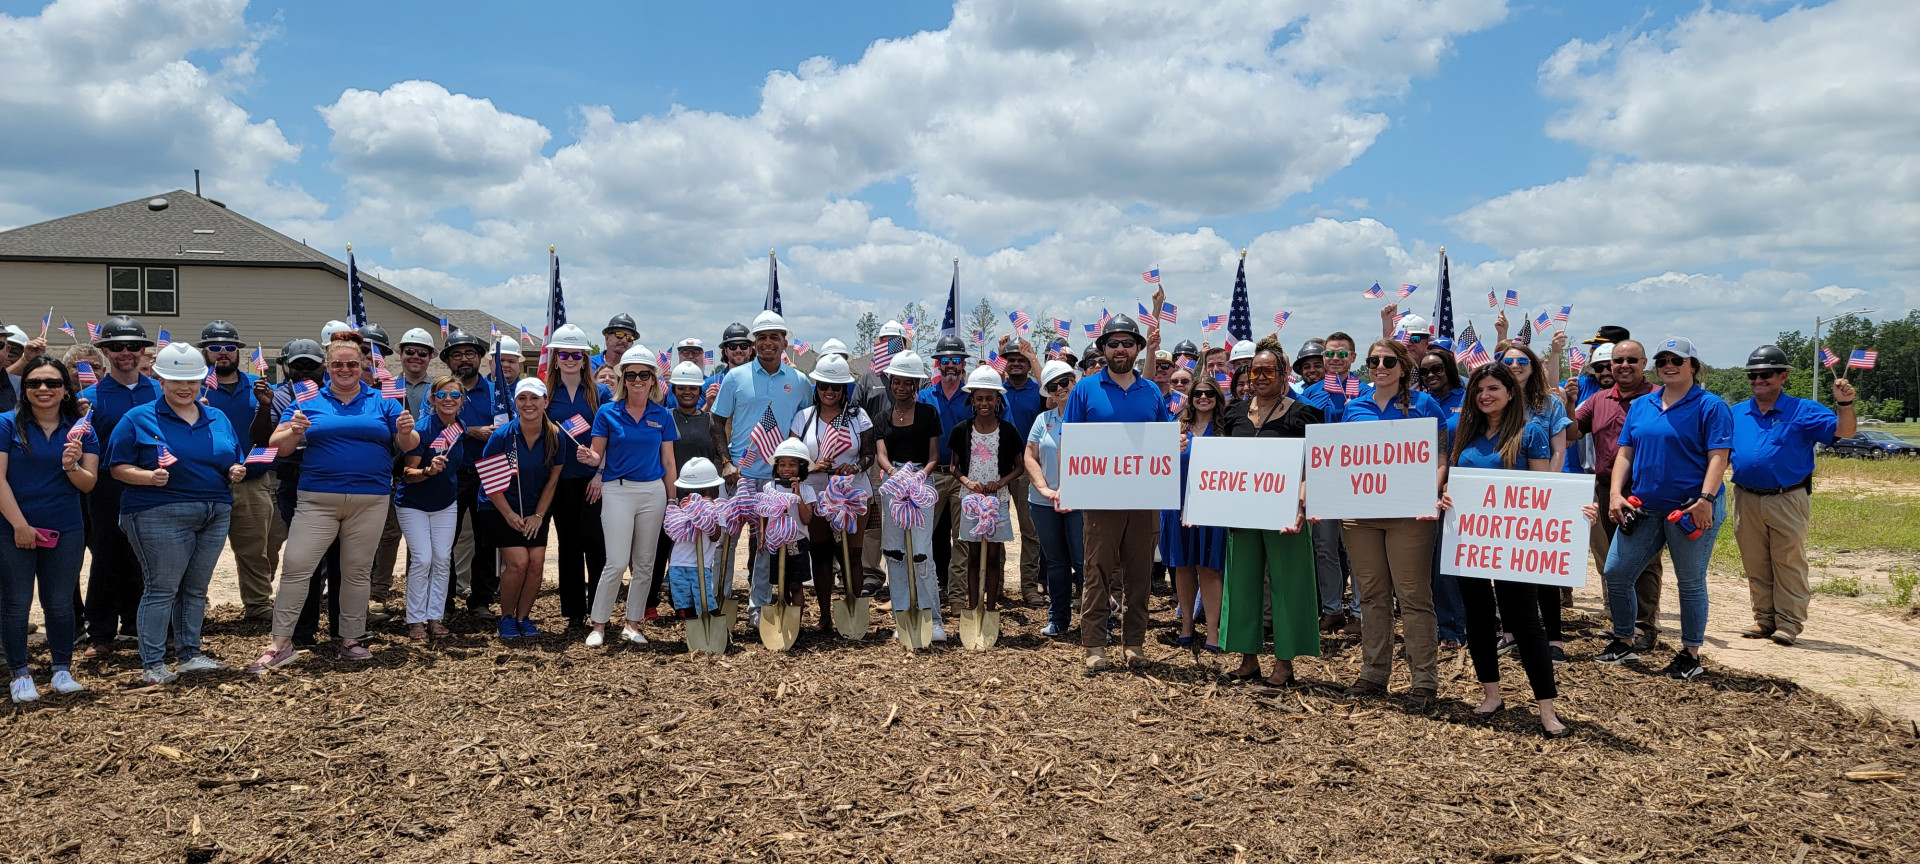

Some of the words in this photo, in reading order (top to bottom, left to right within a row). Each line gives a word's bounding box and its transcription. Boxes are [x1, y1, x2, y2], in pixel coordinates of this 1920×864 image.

[1068, 455, 1108, 476] NOW
[1114, 455, 1144, 476] LET
[1149, 455, 1172, 476] US
[1311, 445, 1335, 469] BY
[1340, 440, 1430, 467] BUILDING
[1198, 470, 1248, 492] SERVE
[1253, 472, 1286, 494] YOU
[1350, 473, 1387, 495] YOU
[1482, 484, 1497, 508] A
[1503, 485, 1552, 511] NEW
[1458, 513, 1573, 544] MORTGAGE
[1454, 543, 1504, 570] FREE
[1510, 547, 1571, 576] HOME
